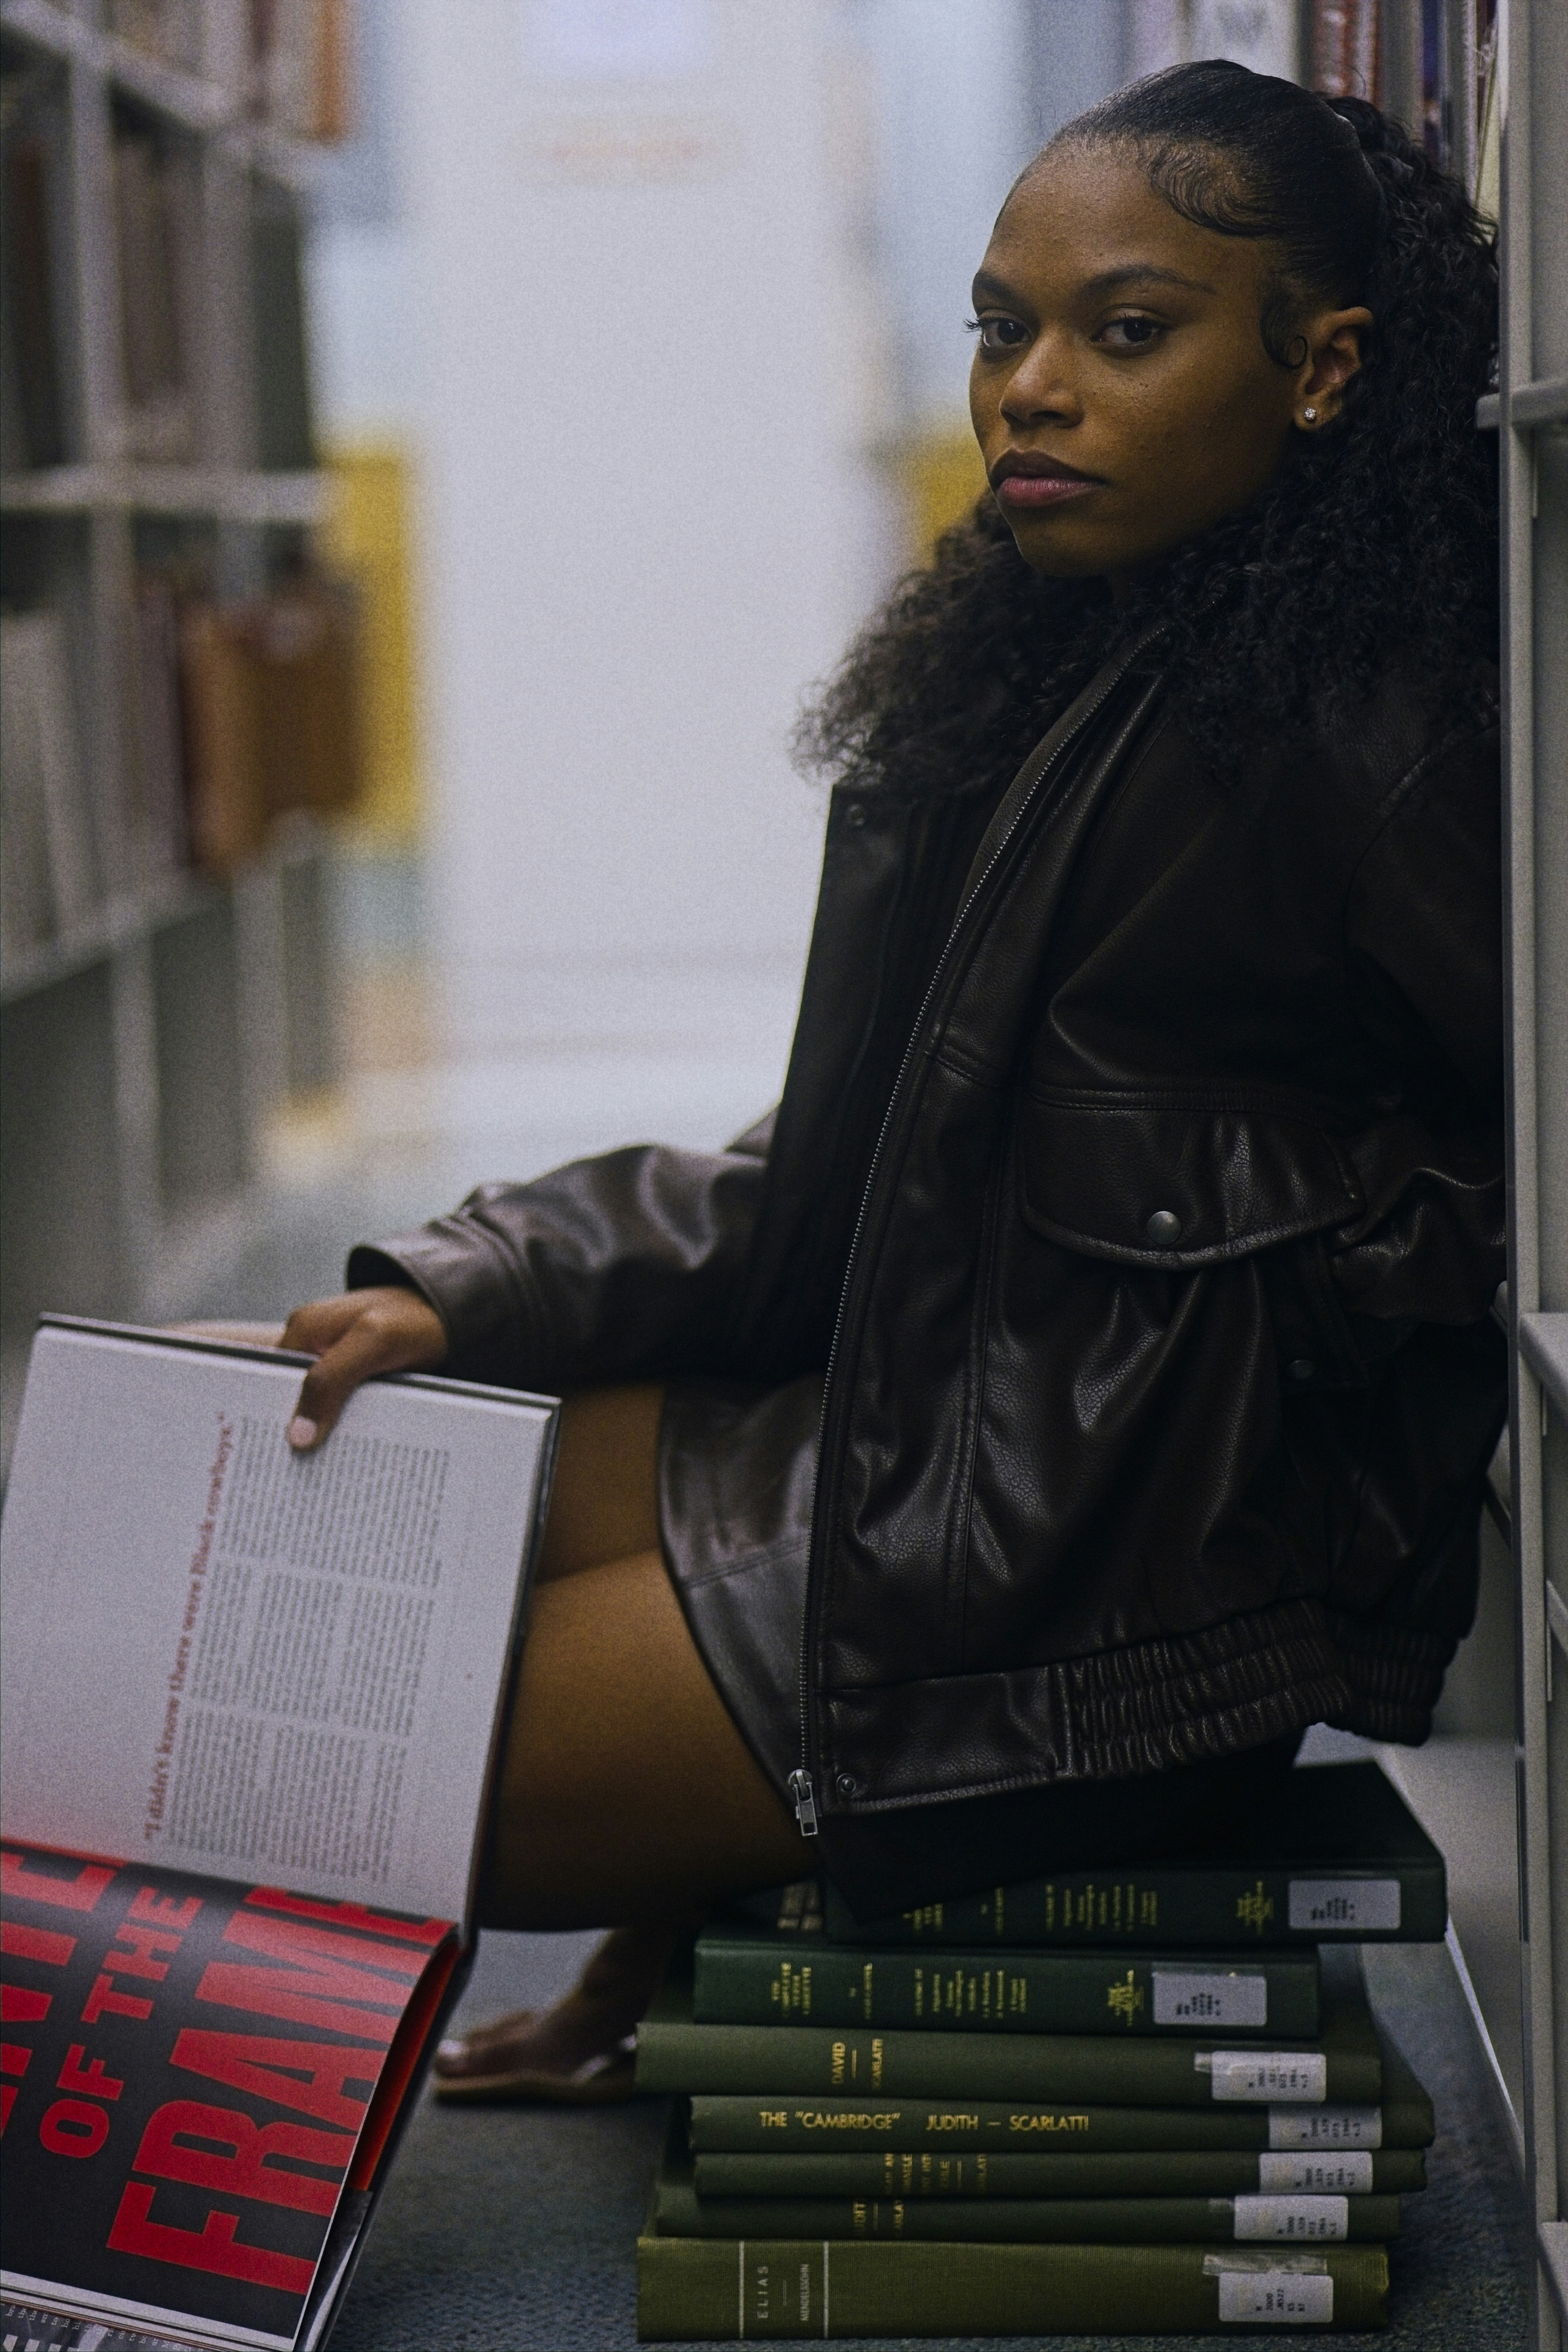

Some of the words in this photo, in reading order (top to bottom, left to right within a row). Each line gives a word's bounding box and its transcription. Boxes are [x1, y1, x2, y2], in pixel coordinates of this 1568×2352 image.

[189, 1517, 216, 1575] Black
[182, 1579, 202, 1631] were
[167, 1636, 192, 1692] there
[155, 1697, 180, 1754] know
[81, 1886, 203, 2024] THE
[106, 1884, 458, 2295] FRAME
[831, 2042, 846, 2085] DAVID
[40, 2043, 124, 2158] OF
[759, 2111, 787, 2127] THE
[795, 2111, 900, 2129] "CAMBRIDGE"
[926, 2115, 978, 2131] JUDITH
[1009, 2115, 1089, 2131] SCARLATTI
[757, 2266, 769, 2319] ELIAS
